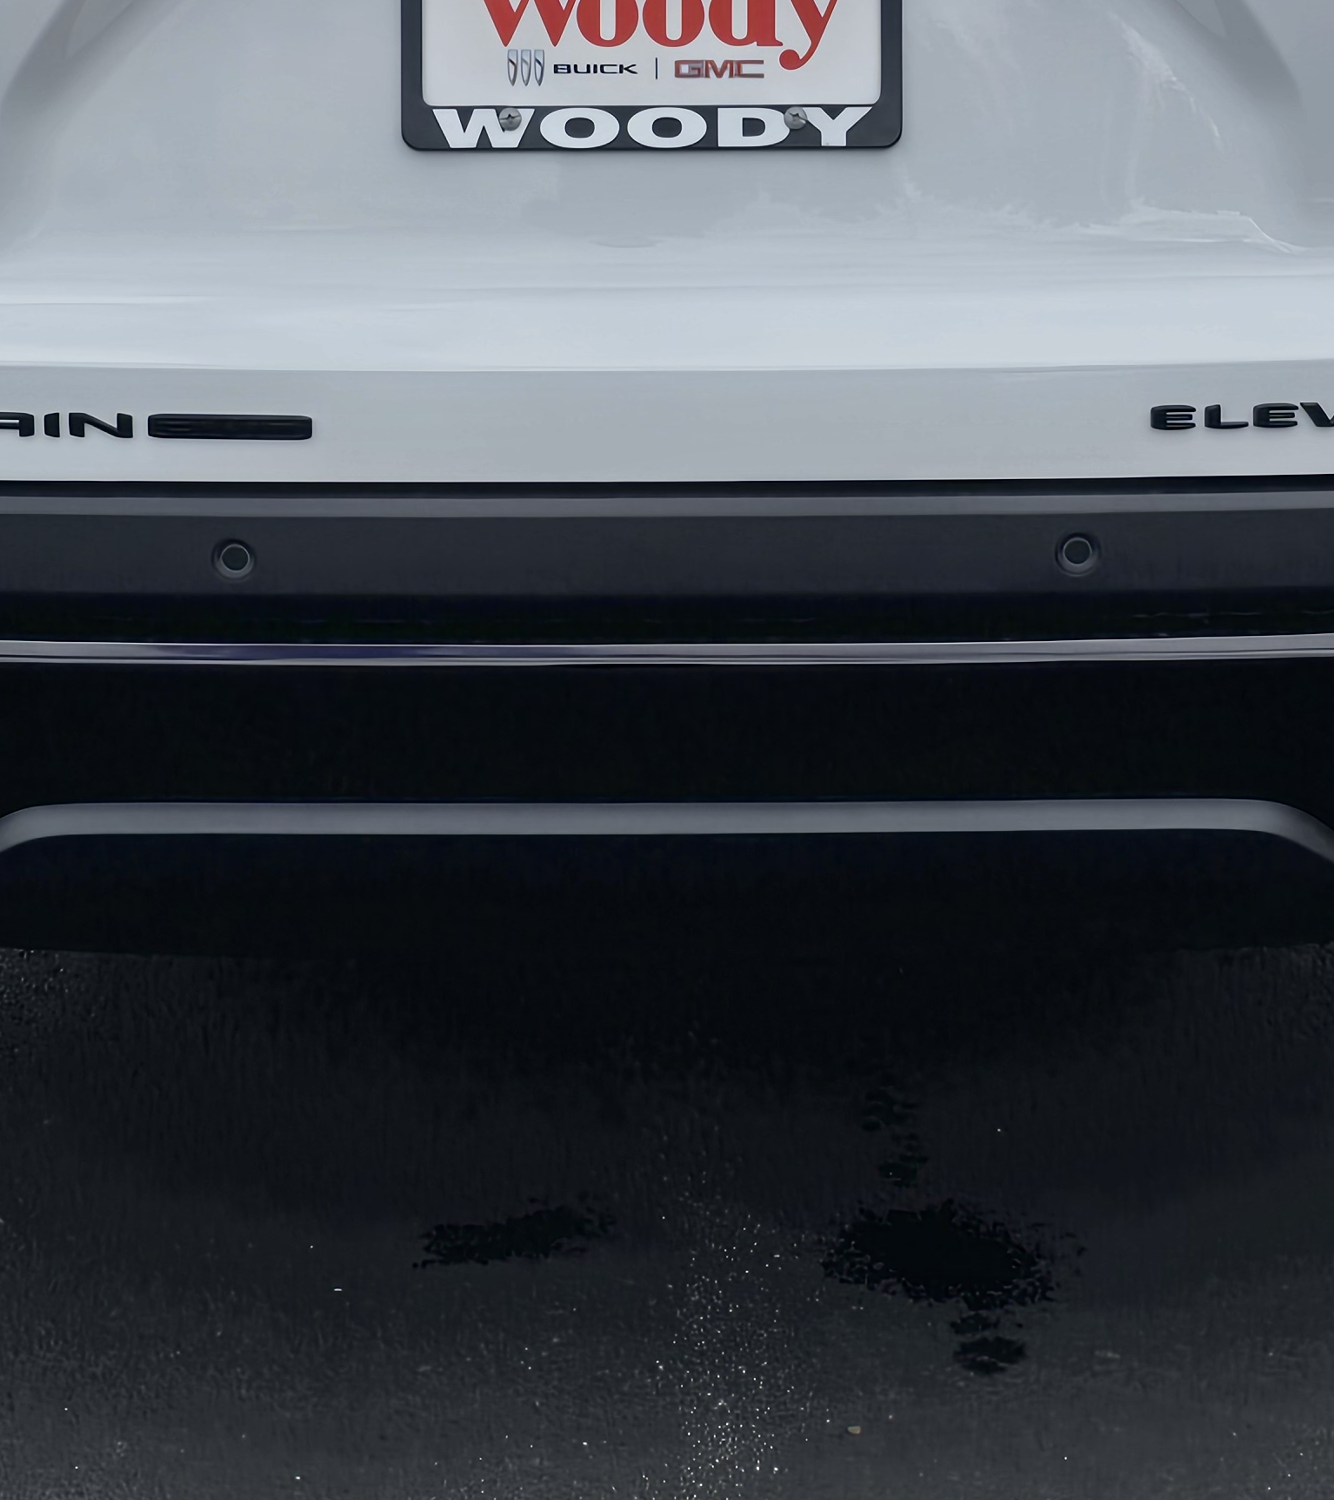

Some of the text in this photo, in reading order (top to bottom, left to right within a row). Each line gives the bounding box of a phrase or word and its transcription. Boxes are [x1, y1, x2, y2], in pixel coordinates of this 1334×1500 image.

[553, 59, 765, 79] BUICK GMC
[432, 106, 873, 150] WOODY
